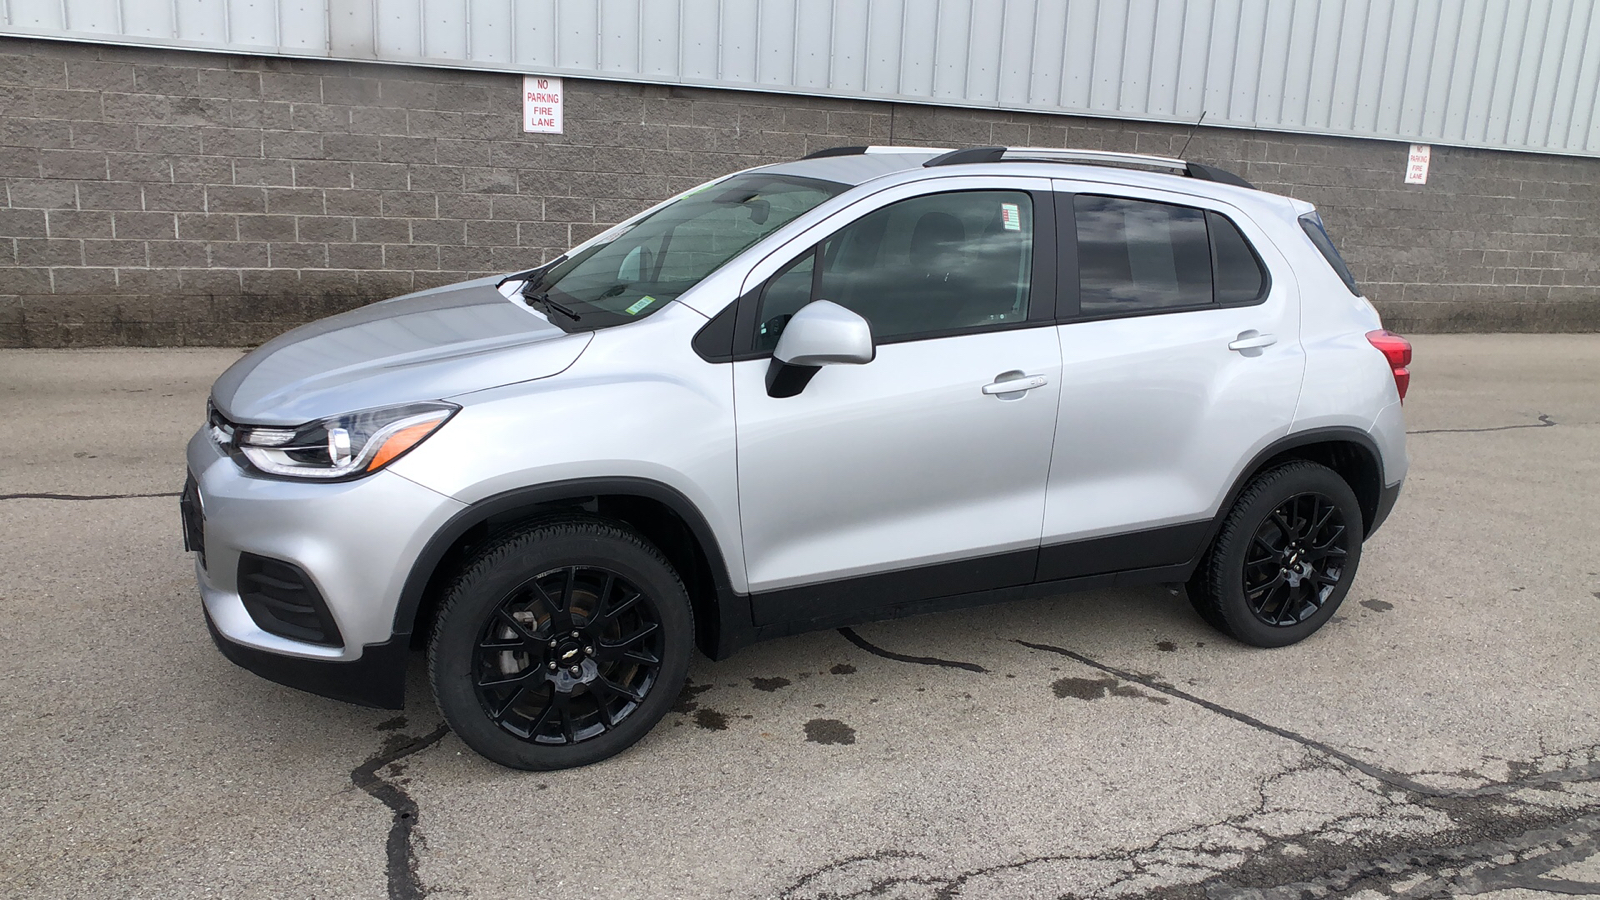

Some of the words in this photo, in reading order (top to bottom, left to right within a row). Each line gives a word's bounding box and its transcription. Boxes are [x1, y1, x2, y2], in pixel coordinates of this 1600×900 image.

[537, 79, 549, 90] NO
[527, 92, 559, 104] PARKING
[533, 106, 553, 116] FIRE
[531, 117, 555, 127] LANE
